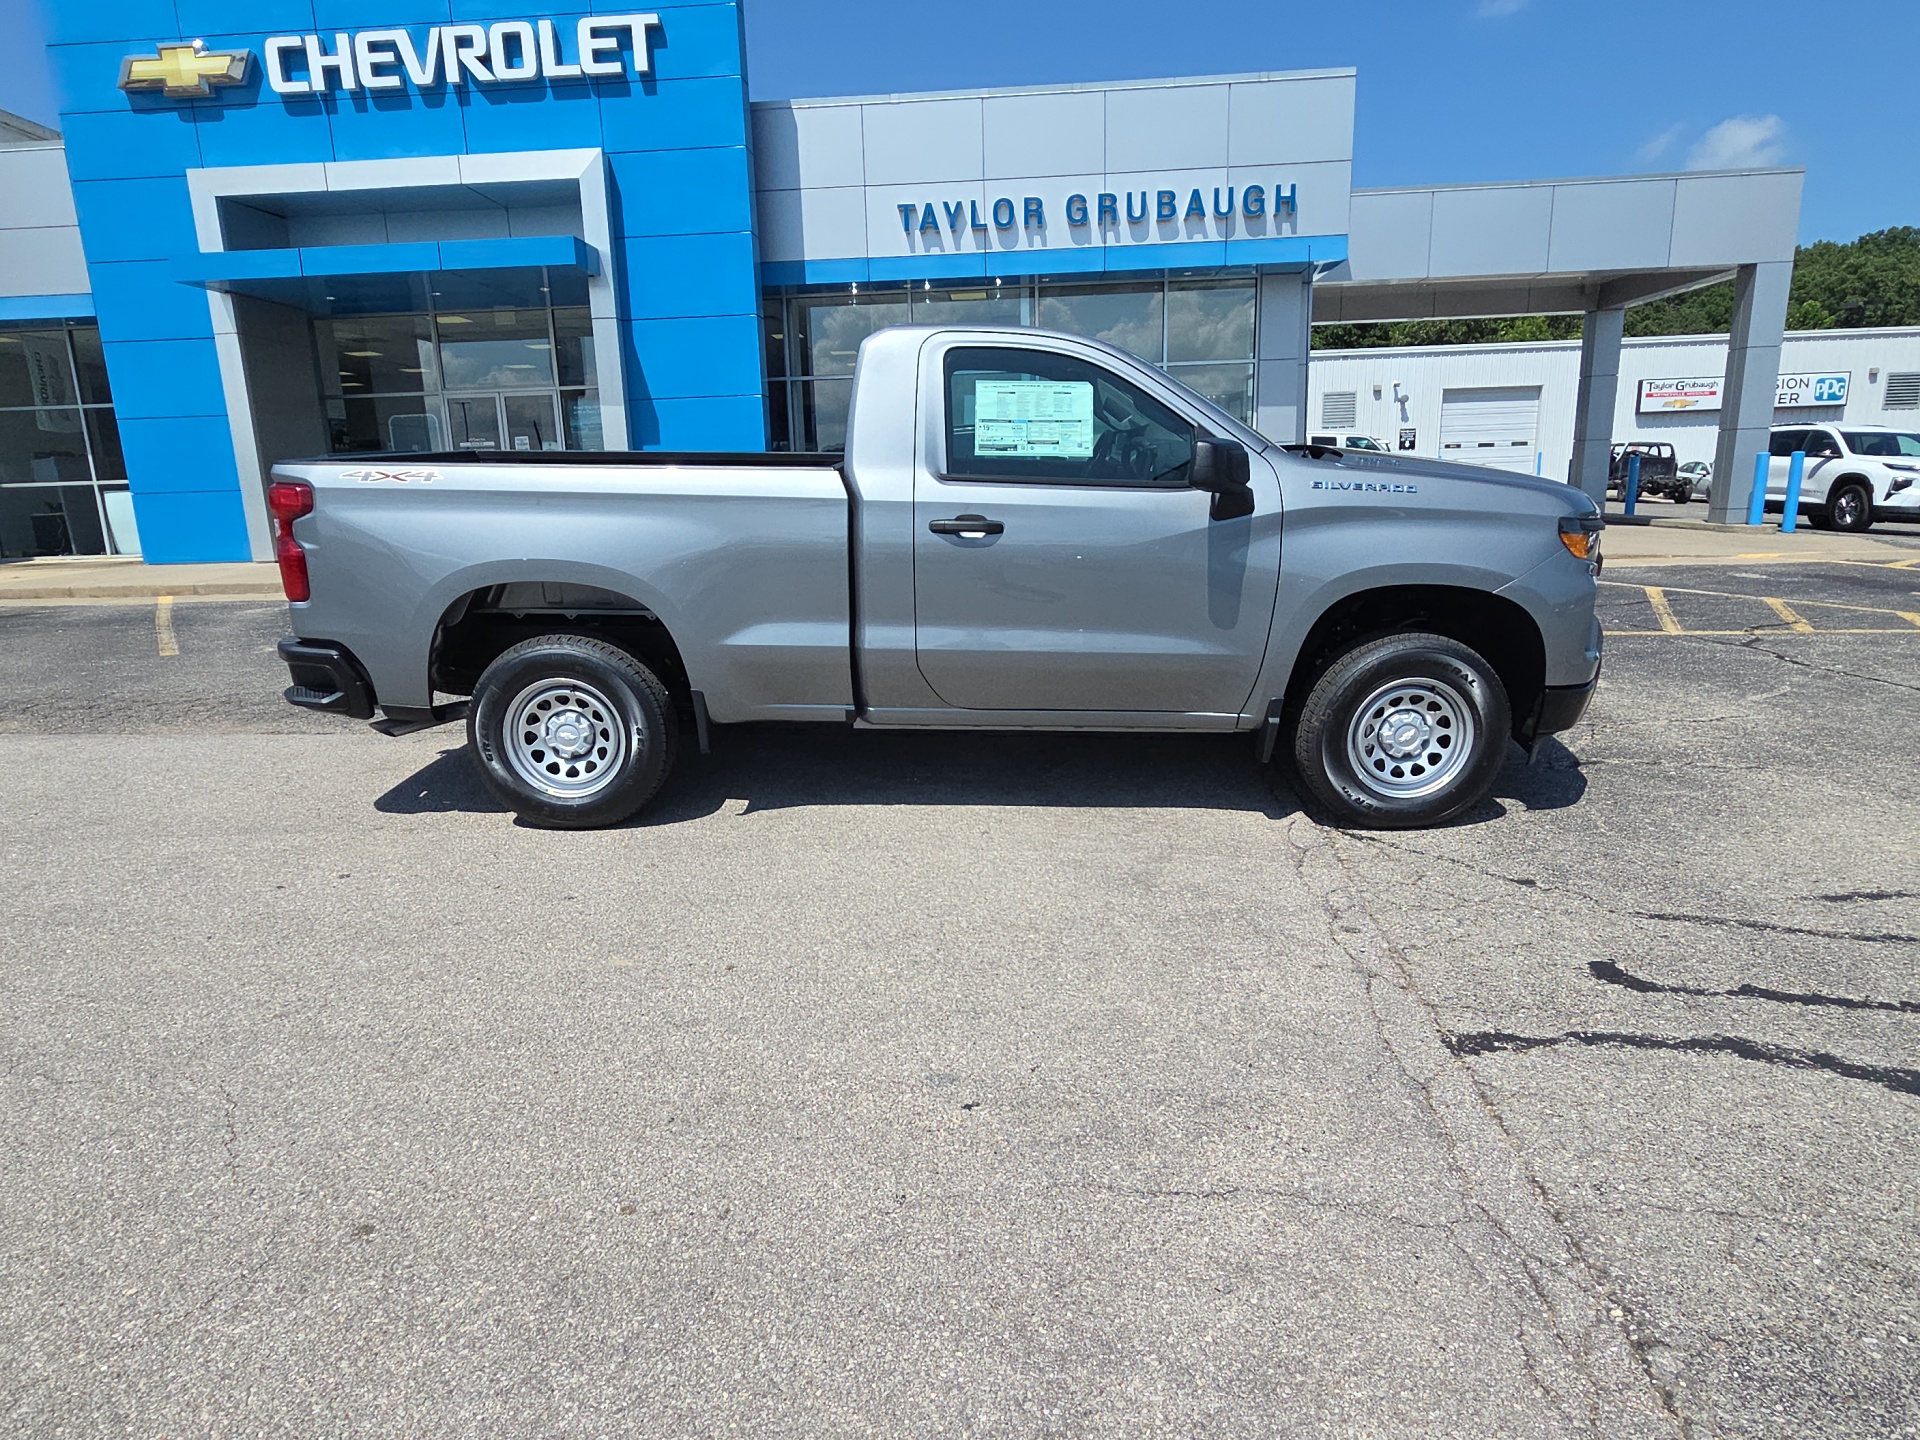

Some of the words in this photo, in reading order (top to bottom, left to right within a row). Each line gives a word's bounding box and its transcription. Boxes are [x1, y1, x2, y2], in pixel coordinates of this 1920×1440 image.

[264, 13, 659, 94] CHEVROLET
[897, 197, 1044, 234] TAYLOR
[1065, 183, 1298, 224] GRUBAUGH
[1646, 381, 1675, 392] Taylor
[1675, 380, 1719, 391] Grubaugh
[1815, 379, 1846, 400] PPG
[1775, 392, 1800, 404] ER
[1310, 480, 1418, 494] SILVERADO
